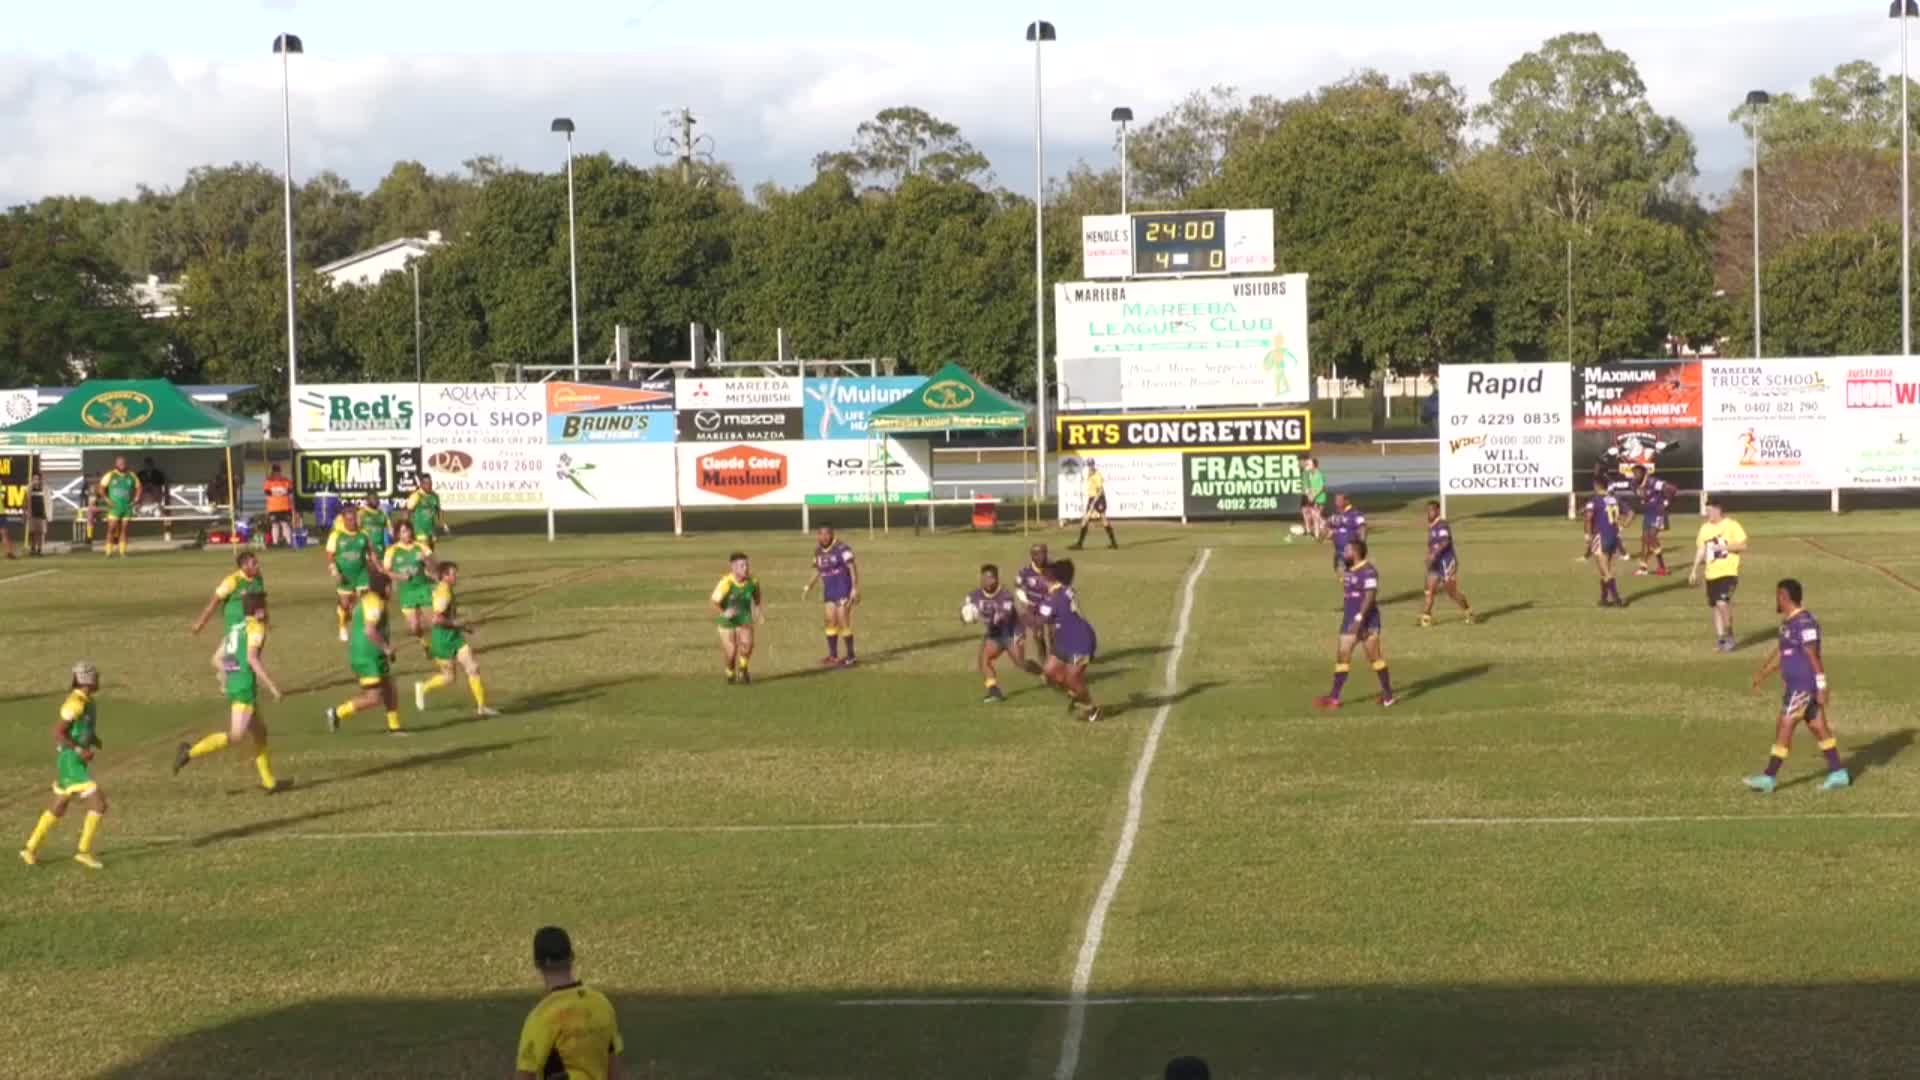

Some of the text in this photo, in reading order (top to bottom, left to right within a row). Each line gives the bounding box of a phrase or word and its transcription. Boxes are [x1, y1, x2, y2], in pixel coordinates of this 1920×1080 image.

[1146, 221, 1215, 242] 24:00
[1156, 253, 1169, 268] 4
[1210, 250, 1223, 268] 0
[1075, 288, 1127, 302] MAREEBA
[1233, 282, 1287, 297] VISITORS
[1122, 302, 1238, 318] MAREEBA
[1210, 317, 1273, 332] CLUB
[1711, 367, 1763, 376] MAREEBA
[725, 381, 790, 391] MAREEBA
[1467, 369, 1543, 399] Rapid
[1712, 375, 1760, 388] TRUCK
[725, 392, 792, 404] MITSUBISHI
[328, 394, 414, 420] Red's
[425, 412, 543, 427] POOL SHOP
[724, 413, 785, 425] mazda
[1450, 413, 1560, 426] 07 4229 0835
[562, 415, 649, 438] BRUNO'S
[1068, 419, 1301, 445] RTS CONCRETING
[696, 431, 784, 441] MAREEBA MAZDA
[1759, 439, 1792, 449] TOTAL
[1484, 448, 1529, 461] WILL
[1760, 449, 1802, 459] PHYSIO
[702, 456, 745, 469] Claude
[1190, 454, 1301, 480] FRASER
[1472, 462, 1540, 475] BOLTON
[1191, 479, 1302, 496] AUTOMOTIVE
[1448, 476, 1564, 489] CONCRETING
